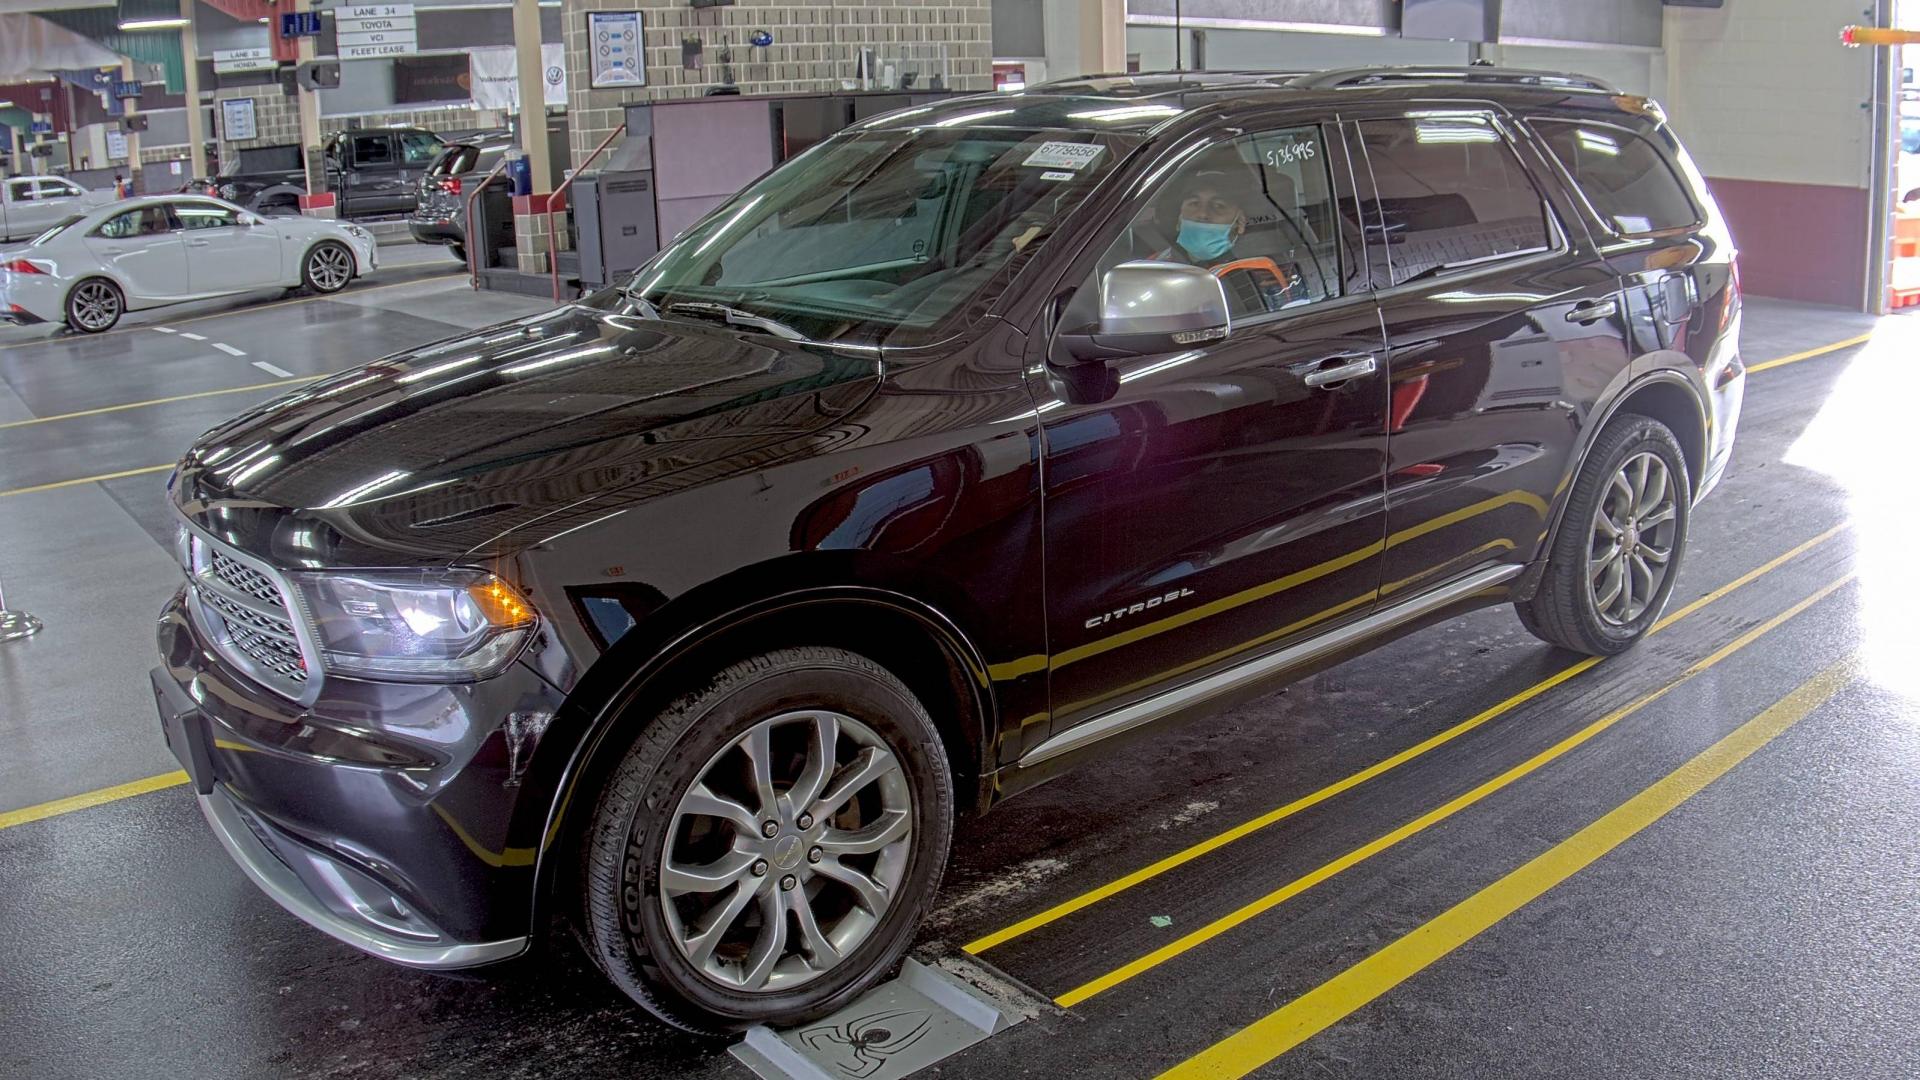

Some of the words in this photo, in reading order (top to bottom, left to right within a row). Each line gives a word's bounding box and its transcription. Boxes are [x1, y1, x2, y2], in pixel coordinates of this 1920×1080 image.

[353, 7, 377, 16] LANE
[385, 7, 396, 15] 34
[360, 20, 393, 30] TOYOTA
[370, 34, 384, 42] VCI
[230, 51, 249, 59] LANE
[351, 47, 376, 56] FLEET
[378, 45, 405, 54] LEASE
[1040, 143, 1100, 157] 6779556
[1084, 587, 1196, 629] CITADEL
